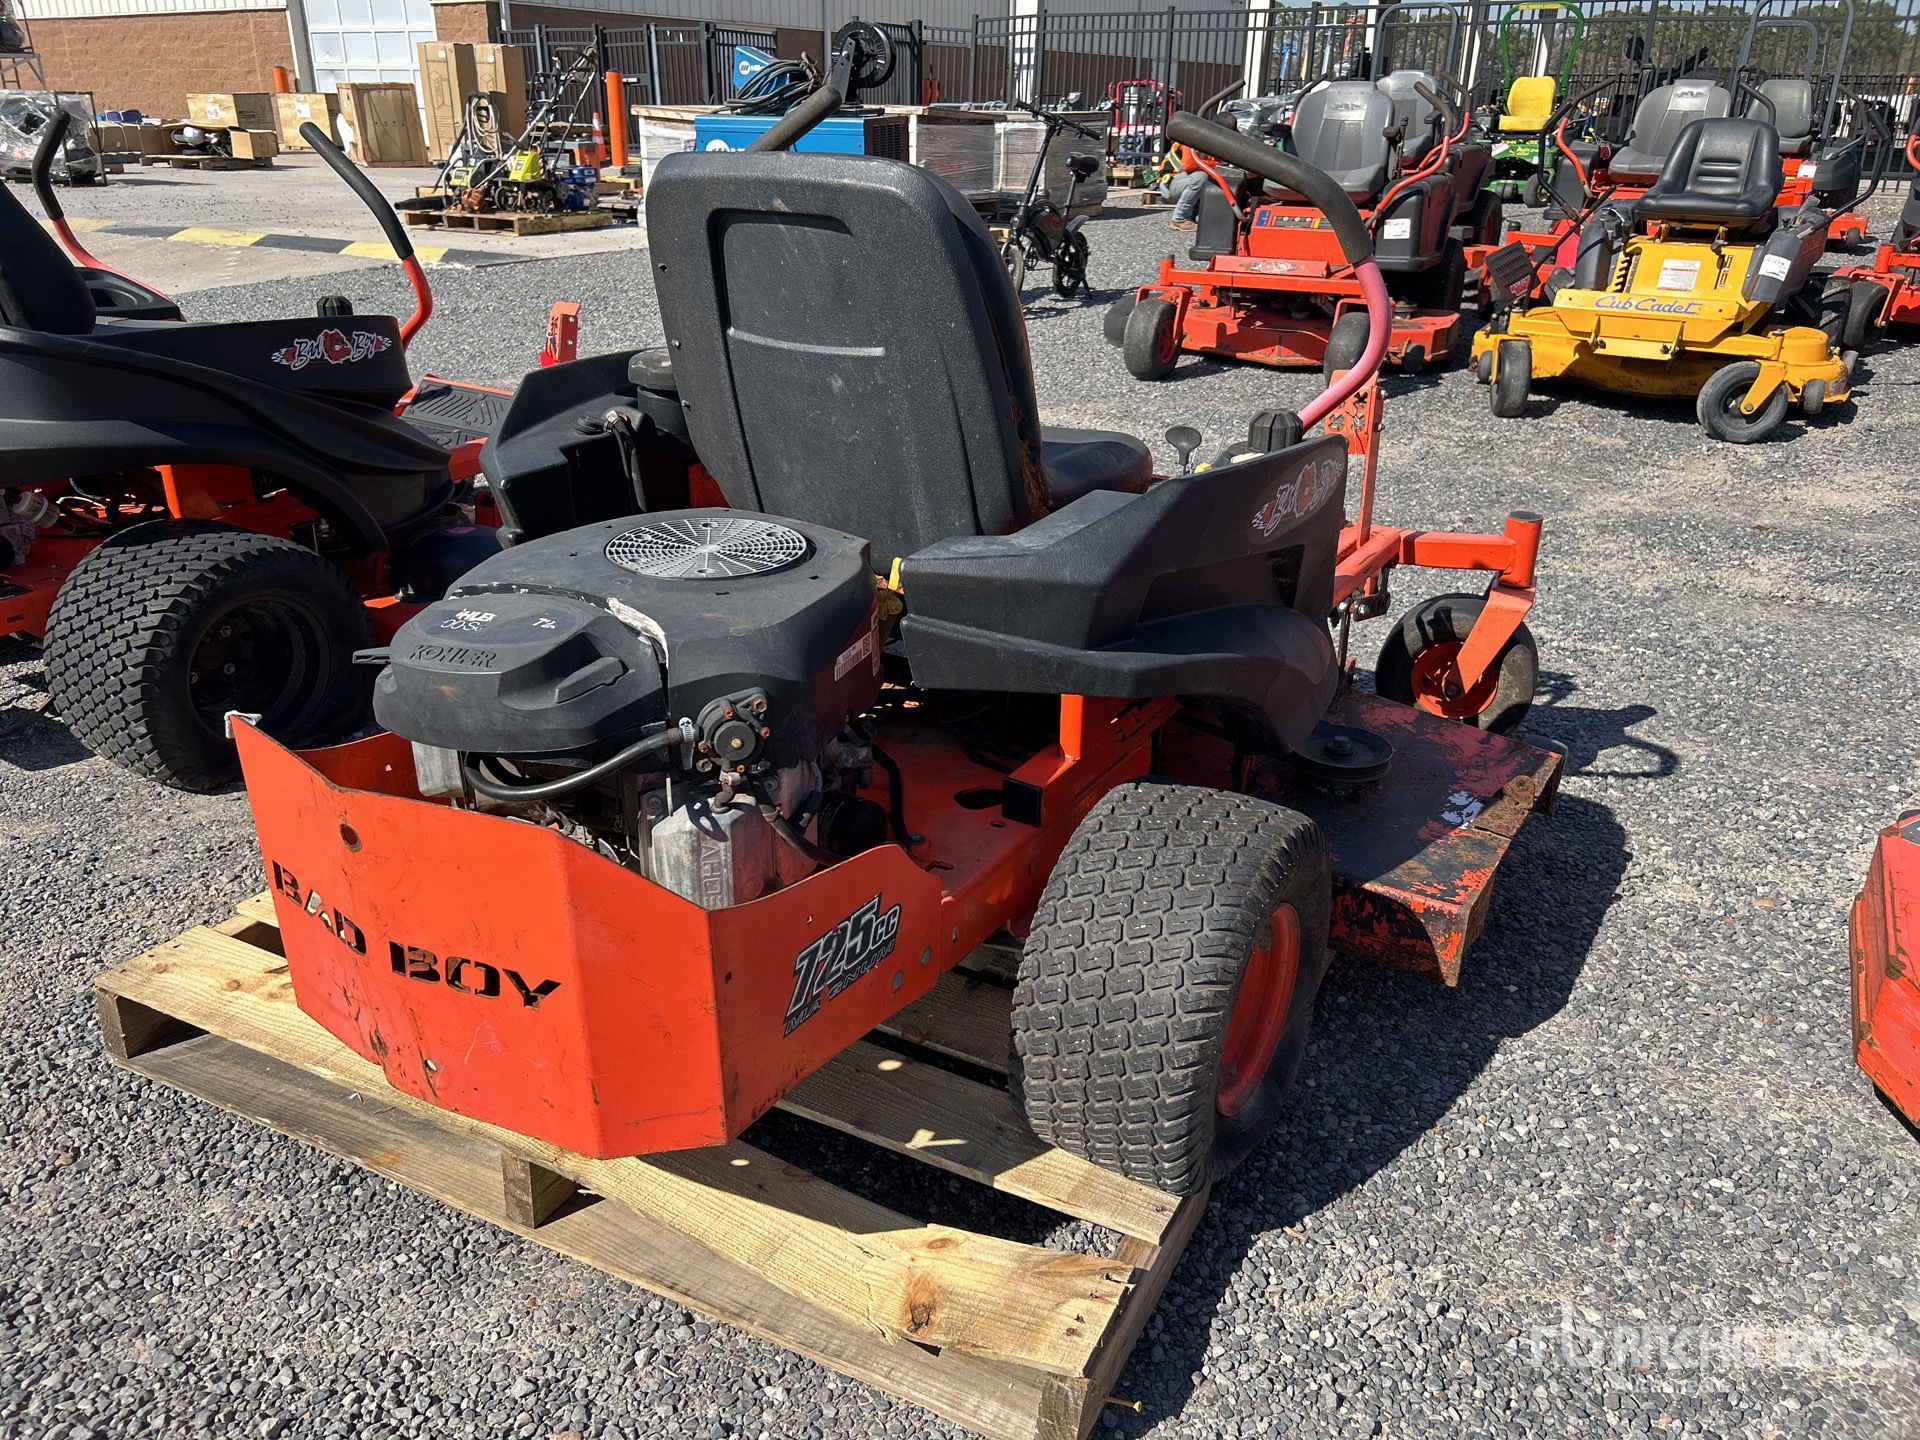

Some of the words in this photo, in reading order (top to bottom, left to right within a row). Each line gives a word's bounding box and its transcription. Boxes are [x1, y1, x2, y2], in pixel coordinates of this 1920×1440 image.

[1594, 295, 1632, 310] Cub
[1635, 298, 1703, 315] Cadet
[291, 334, 327, 370] Bad
[350, 331, 377, 362] Boy
[405, 644, 497, 668] KOHLER
[272, 860, 367, 956] BAD
[388, 940, 562, 1011] BOY
